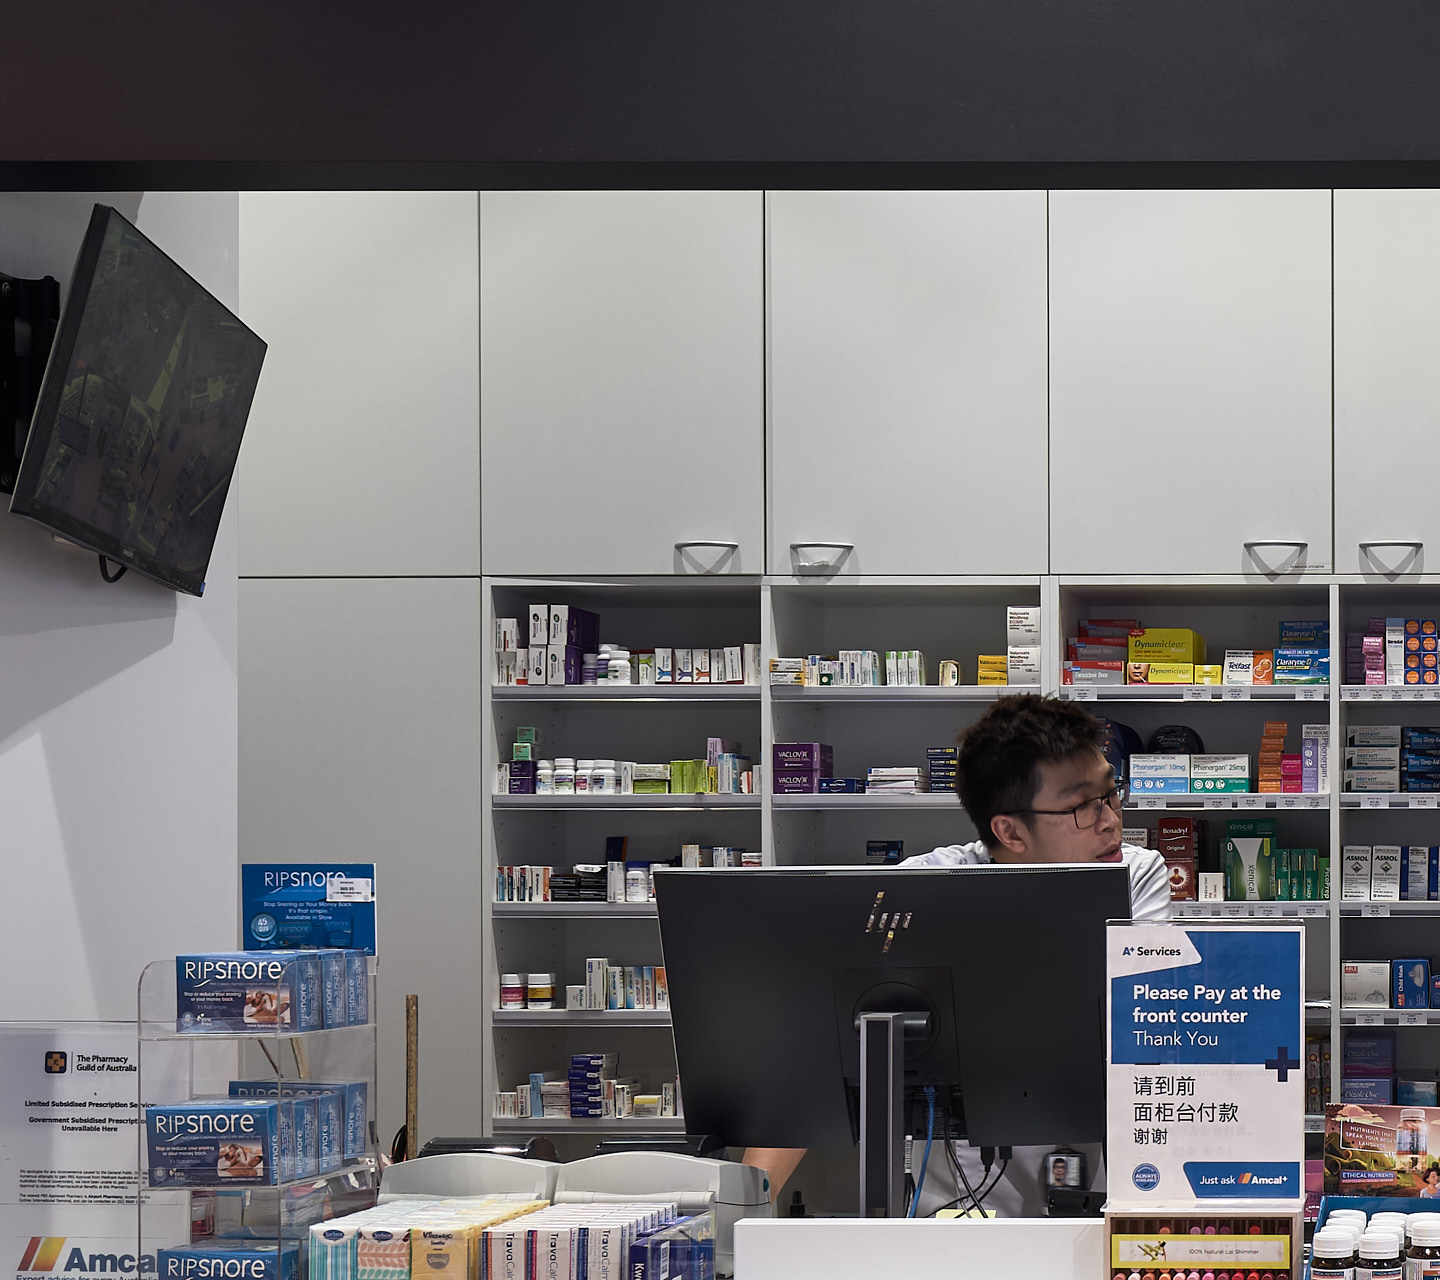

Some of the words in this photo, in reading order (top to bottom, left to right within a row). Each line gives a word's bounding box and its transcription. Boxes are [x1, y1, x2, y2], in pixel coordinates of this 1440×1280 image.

[1137, 946, 1181, 956] Services
[1133, 985, 1189, 1001] Please
[1194, 985, 1225, 1004] Pay
[1231, 987, 1248, 1001] at
[1252, 985, 1281, 1001] the
[1133, 1007, 1177, 1023] front
[1181, 1010, 1248, 1023] counter
[1133, 1031, 1182, 1046] Thank
[1186, 1031, 1218, 1046] You
[92, 1055, 128, 1064] Pharmacy
[105, 1064, 137, 1072] Australia
[1133, 1076, 1196, 1096] 请到前
[51, 1100, 86, 1108] Subsidised
[88, 1101, 128, 1109] Prescription
[1133, 1103, 1239, 1123] 面柜台付款
[29, 1116, 69, 1124] Government
[1133, 1128, 1168, 1145] 谢谢
[1200, 1175, 1218, 1185] Just
[1220, 1175, 1236, 1185] ask
